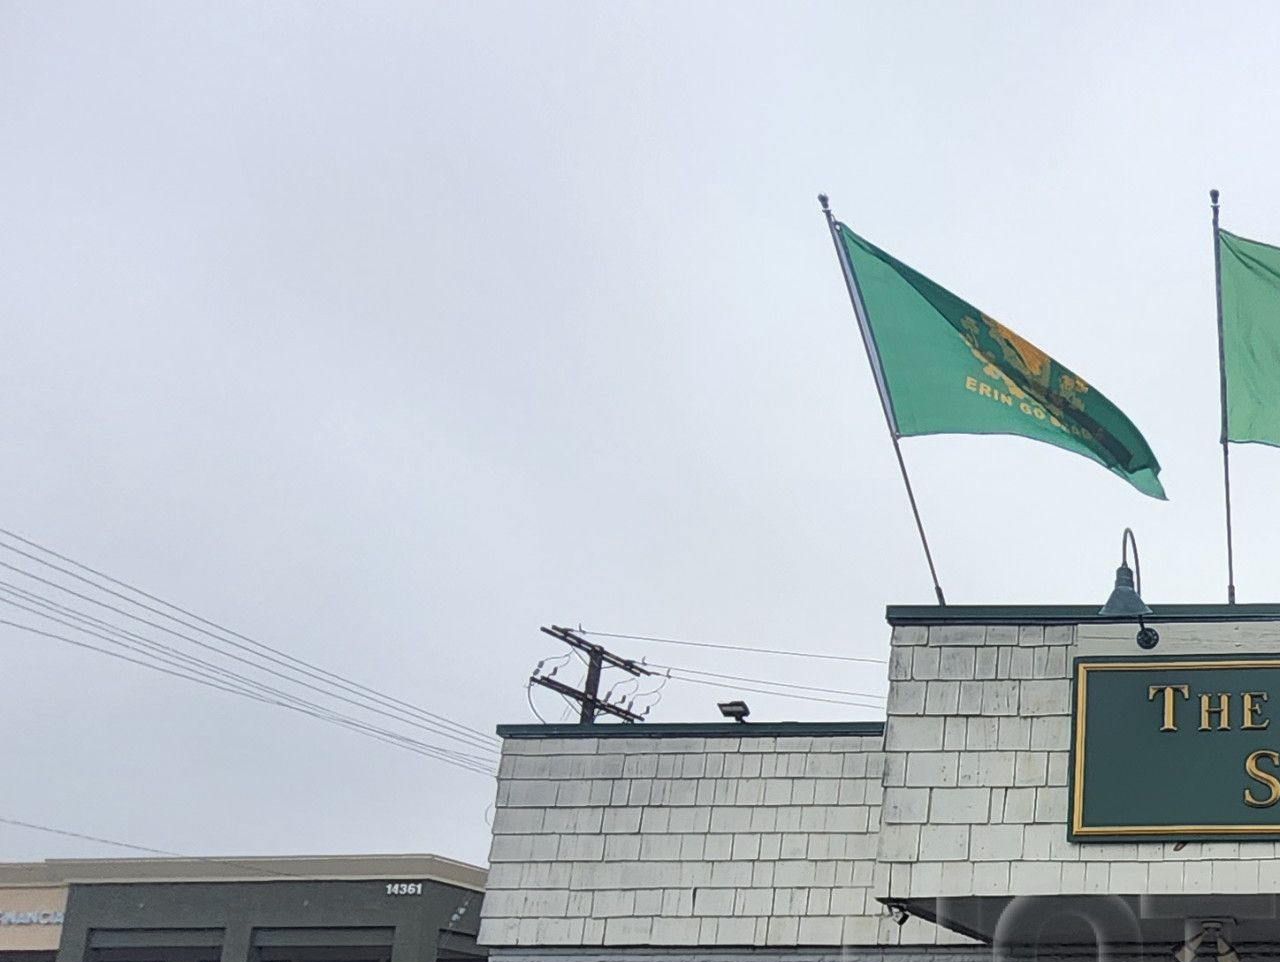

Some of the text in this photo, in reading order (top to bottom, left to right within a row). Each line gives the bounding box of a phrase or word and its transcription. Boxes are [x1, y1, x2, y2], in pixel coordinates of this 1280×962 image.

[965, 375, 1013, 406] ERIN
[1149, 683, 1270, 732] THE
[385, 882, 423, 896] 14361
